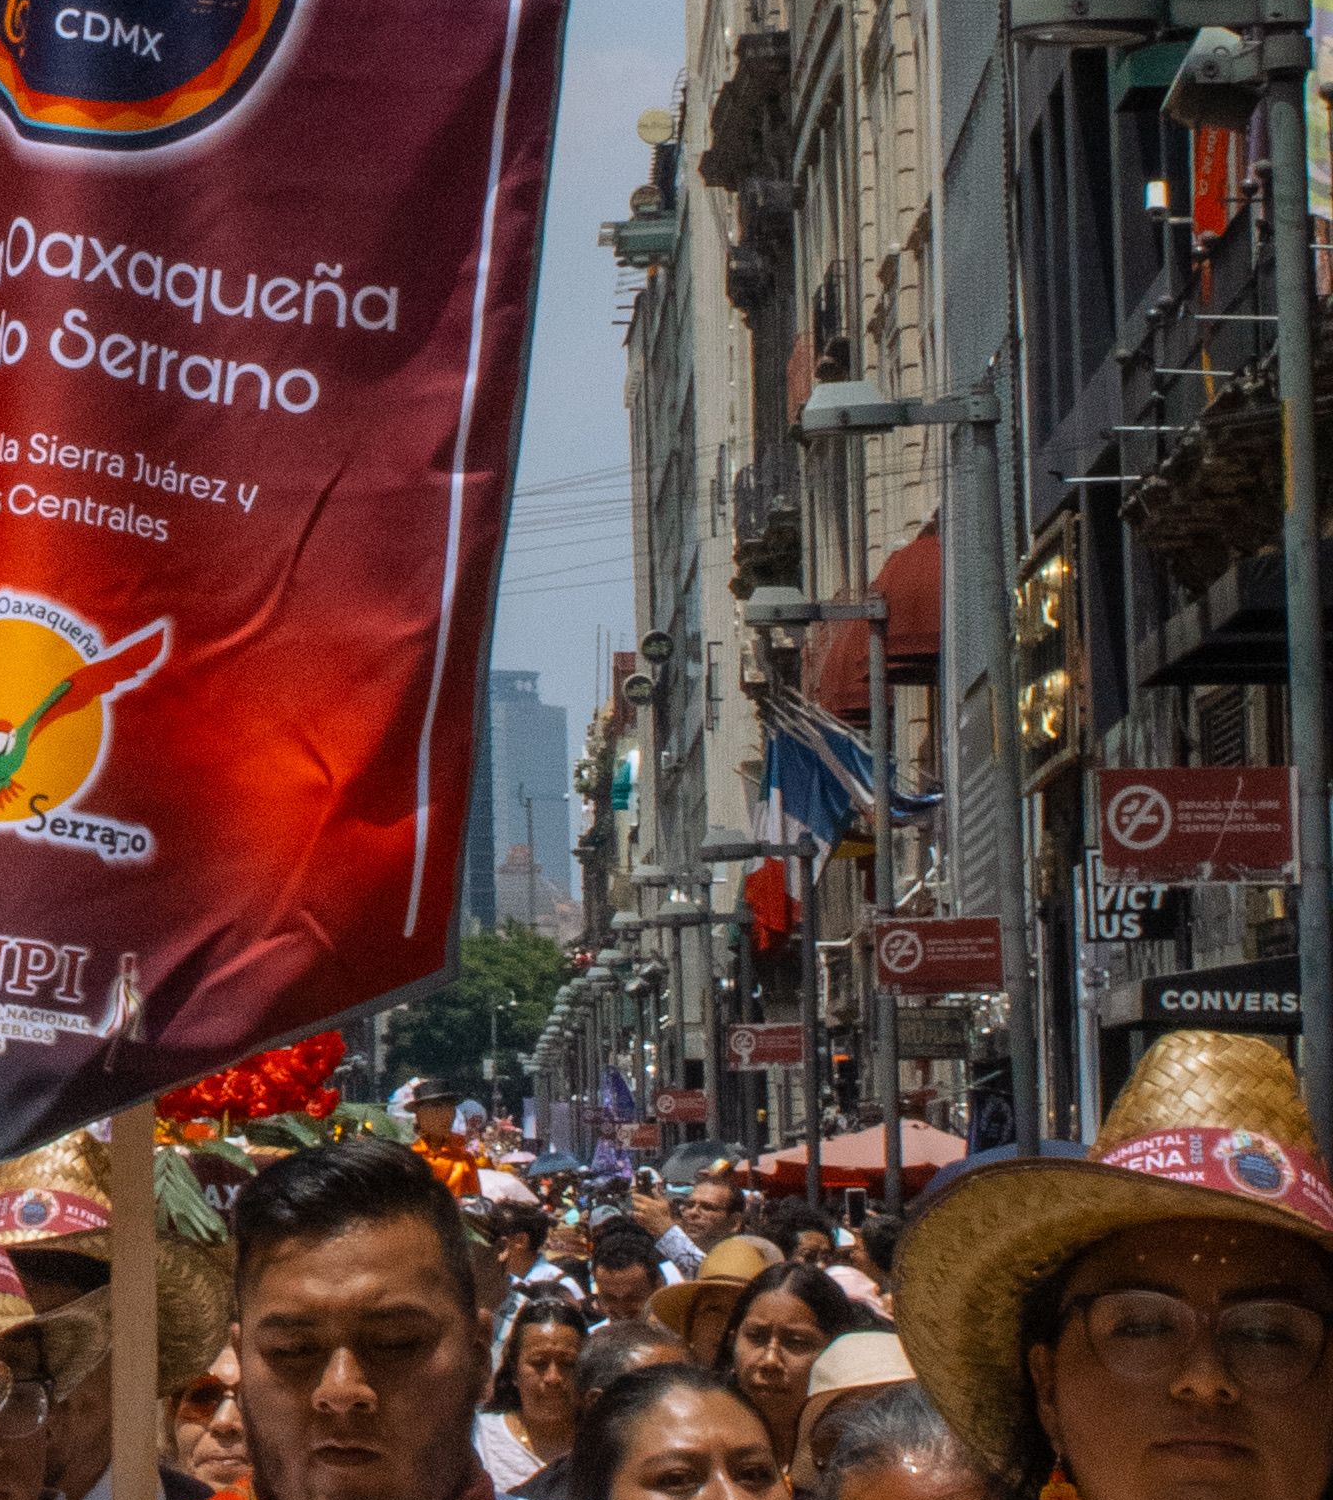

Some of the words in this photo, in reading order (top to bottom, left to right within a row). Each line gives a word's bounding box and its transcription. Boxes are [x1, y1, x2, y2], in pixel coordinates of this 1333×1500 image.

[54, 7, 164, 62] CDMX
[5, 216, 398, 332] Oaxaqueña
[48, 308, 320, 414] Serrano
[27, 432, 125, 478] Sierra
[133, 451, 228, 504] Juárez
[236, 482, 259, 513] y
[7, 482, 169, 542] Centrales
[24, 793, 147, 855] Serrano
[1098, 913, 1144, 940] US
[1160, 990, 1300, 1013] CONVERS
